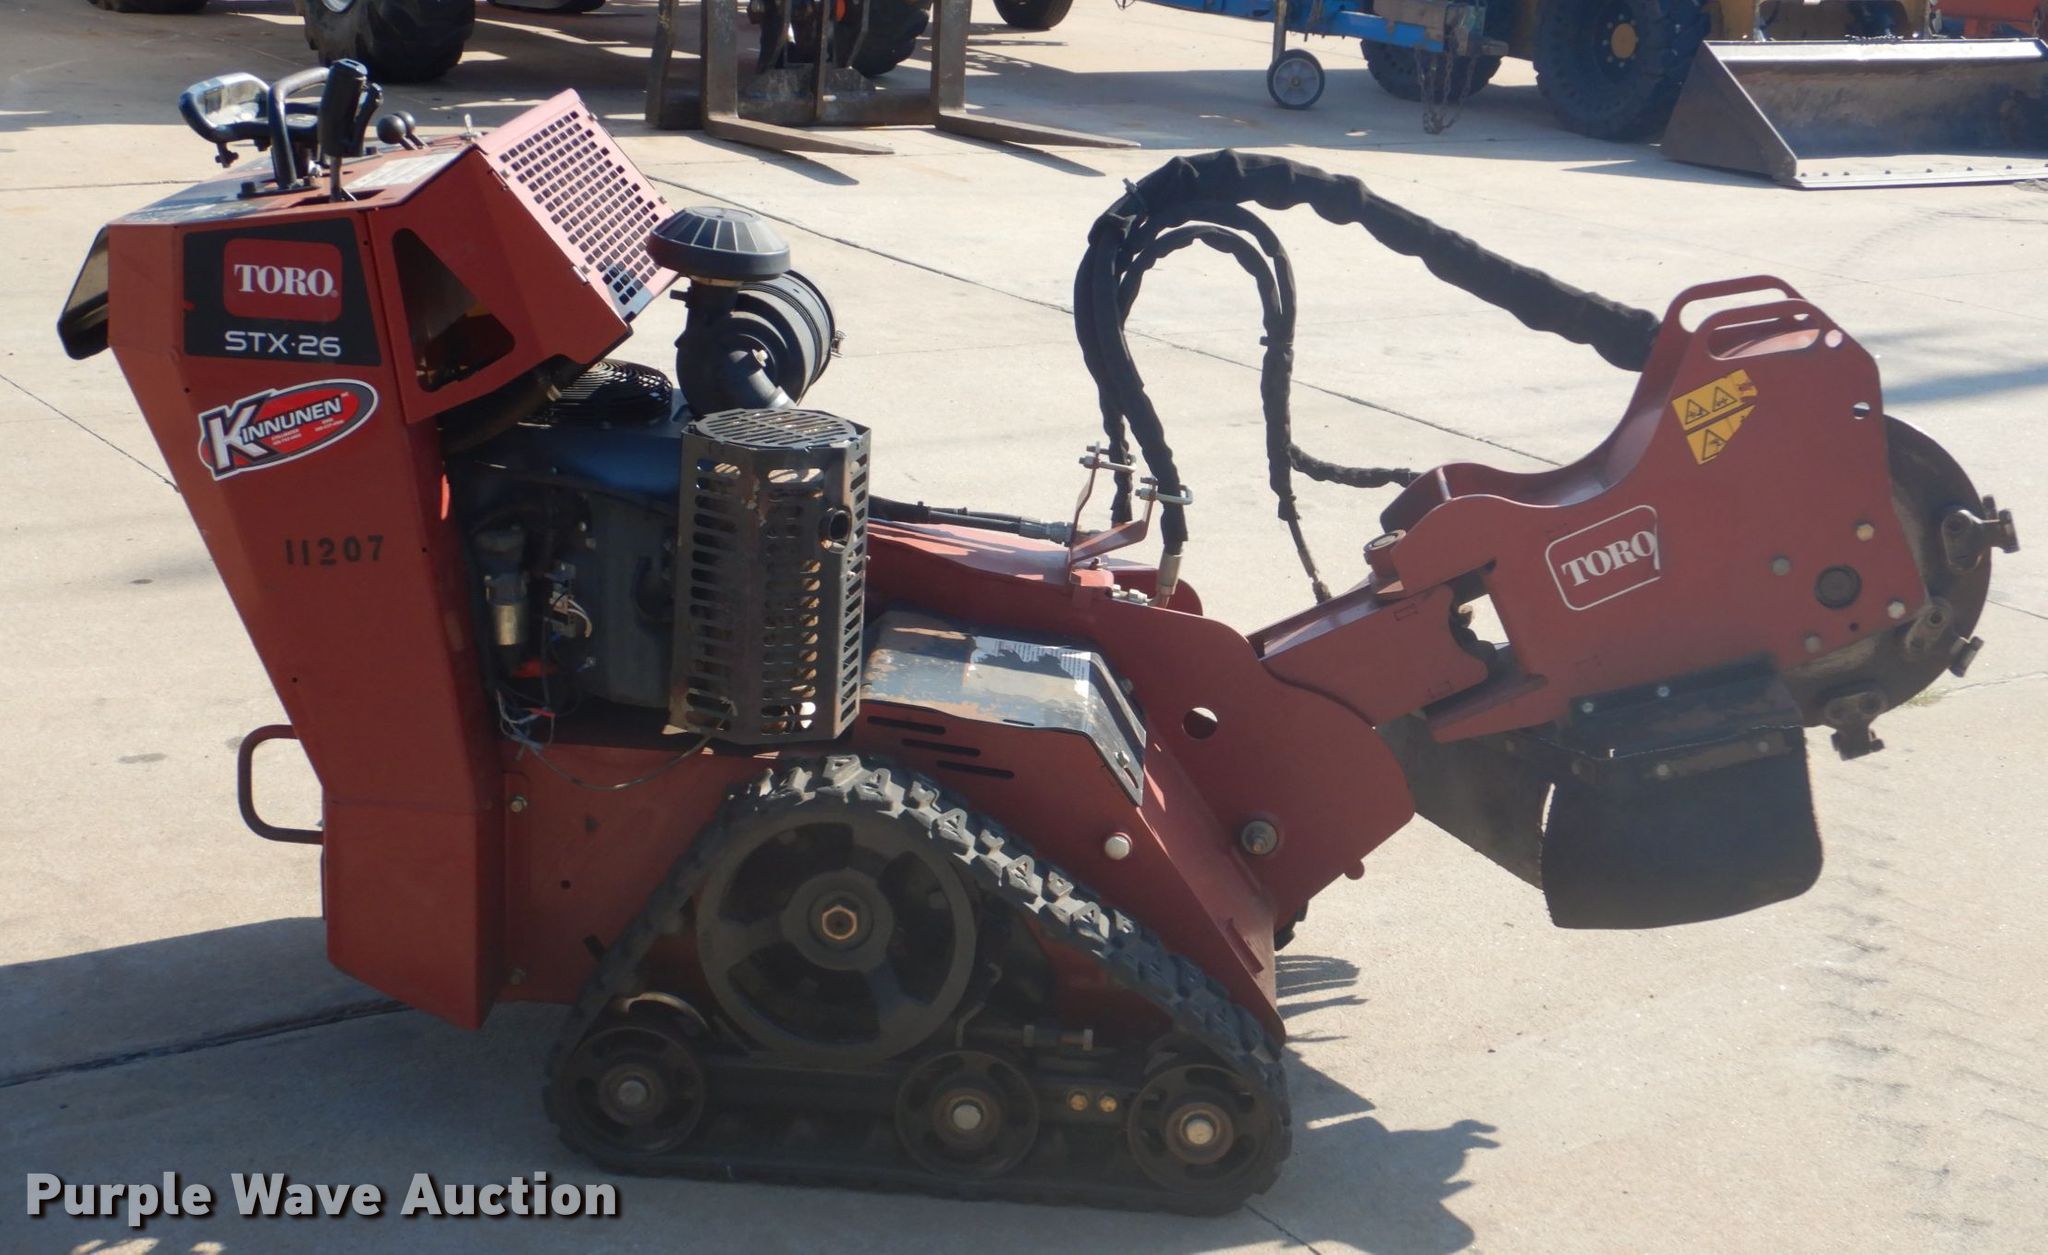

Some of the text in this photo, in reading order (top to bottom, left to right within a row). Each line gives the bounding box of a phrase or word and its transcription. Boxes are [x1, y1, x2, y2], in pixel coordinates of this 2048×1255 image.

[234, 264, 334, 298] TORO
[207, 396, 343, 470] KINNUNEN
[285, 535, 385, 566] 11207
[1561, 530, 1656, 587] TORO
